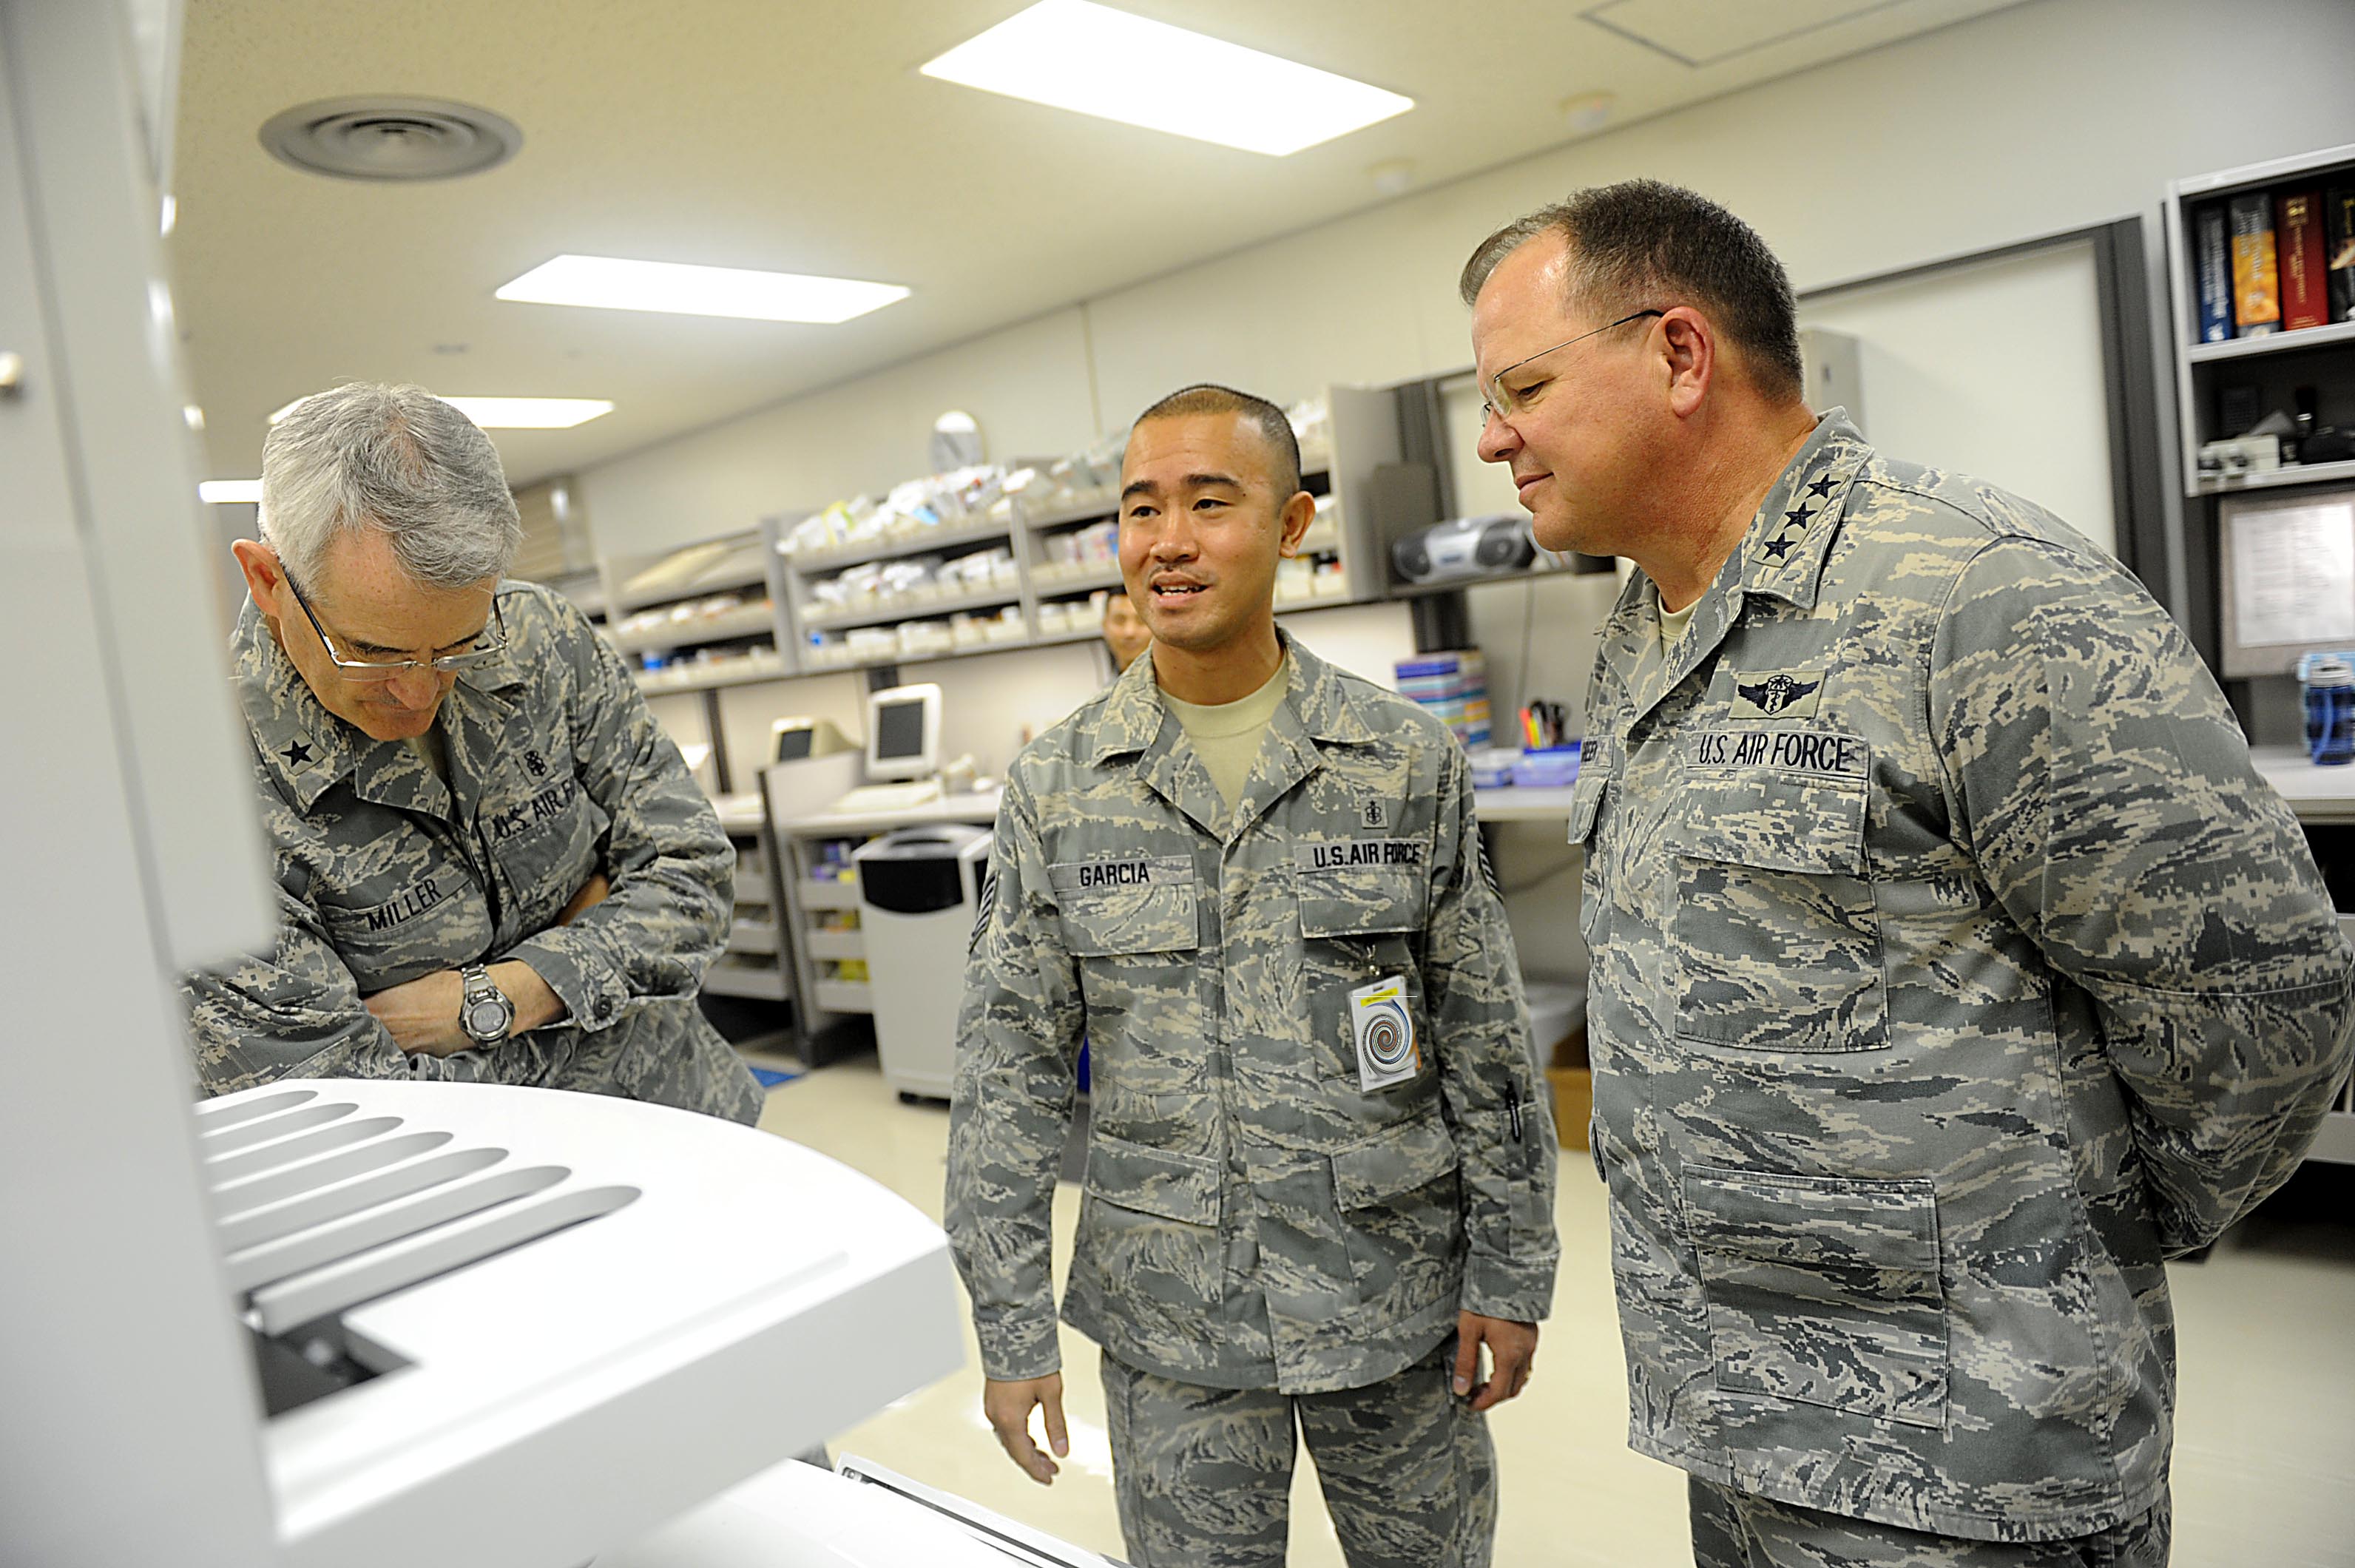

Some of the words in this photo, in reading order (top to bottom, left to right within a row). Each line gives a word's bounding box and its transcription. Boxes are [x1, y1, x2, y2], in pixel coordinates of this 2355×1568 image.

[1699, 734, 1728, 764] U.S.
[1732, 734, 1768, 765] AIR
[1771, 733, 1852, 772] FORCE
[493, 808, 531, 839] U.S.
[531, 790, 564, 821] AIR
[1384, 843, 1420, 864] FORCE
[1080, 862, 1149, 887] GARCIA
[366, 879, 442, 931] MILLER
